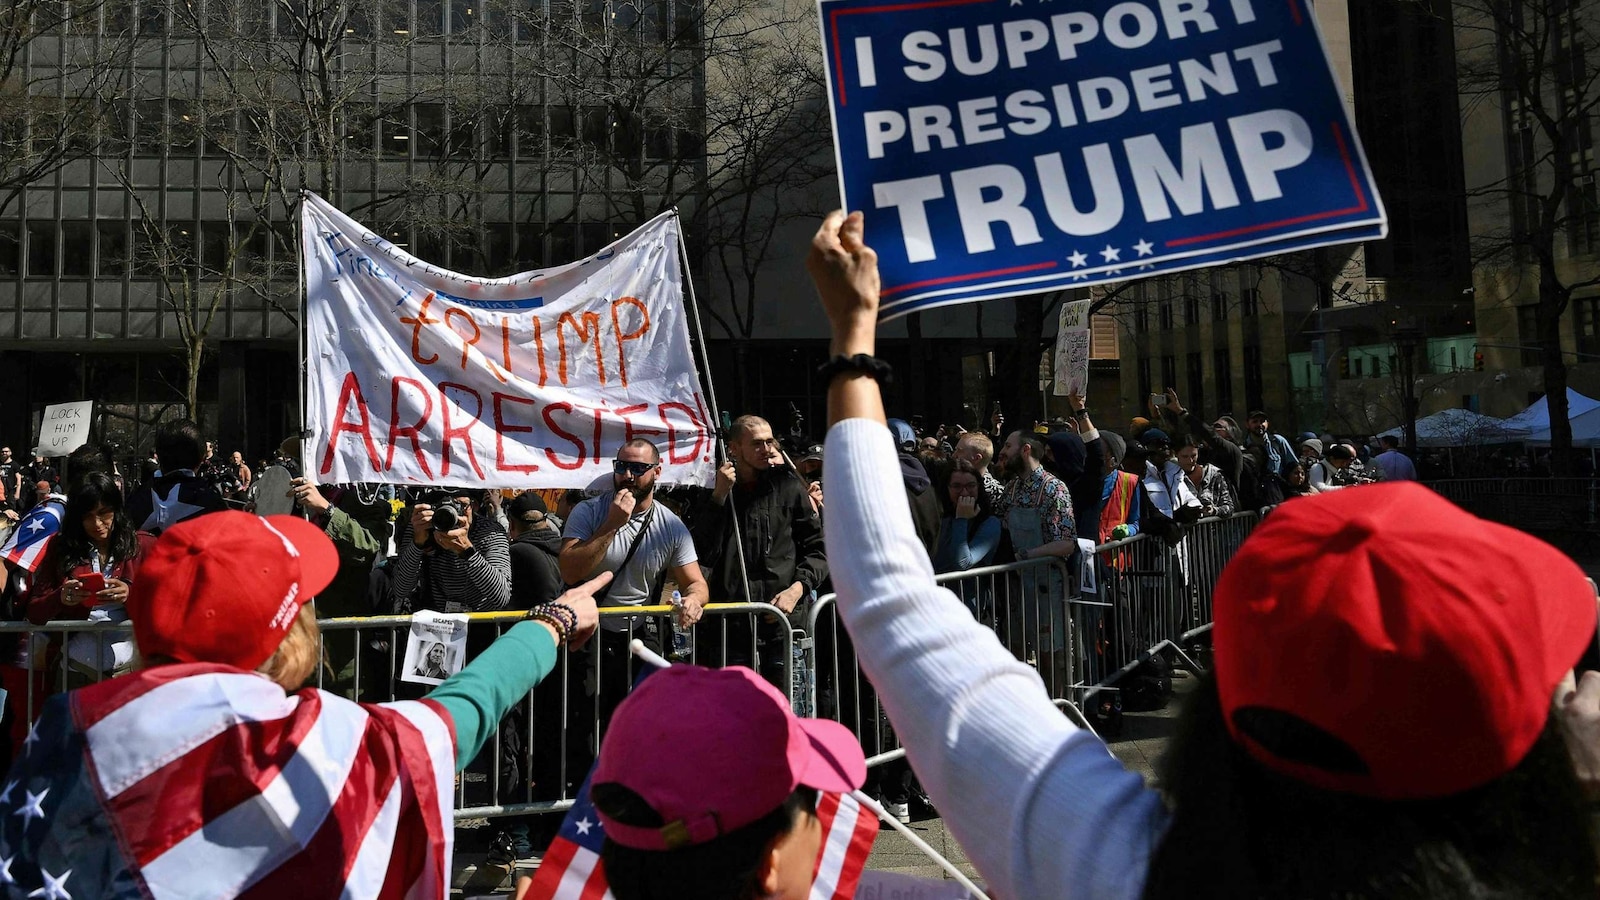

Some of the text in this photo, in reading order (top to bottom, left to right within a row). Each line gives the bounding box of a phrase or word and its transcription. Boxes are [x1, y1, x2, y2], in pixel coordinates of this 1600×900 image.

[854, 0, 1259, 88] I SUPPORT
[864, 39, 1285, 159] PRESIDENT
[871, 108, 1314, 264] TRUMP
[50, 407, 81, 420] LOCK
[51, 436, 69, 447] UP
[54, 423, 76, 433] HIM
[320, 371, 709, 480] ARRESTED!
[268, 582, 298, 629] TRUMP
